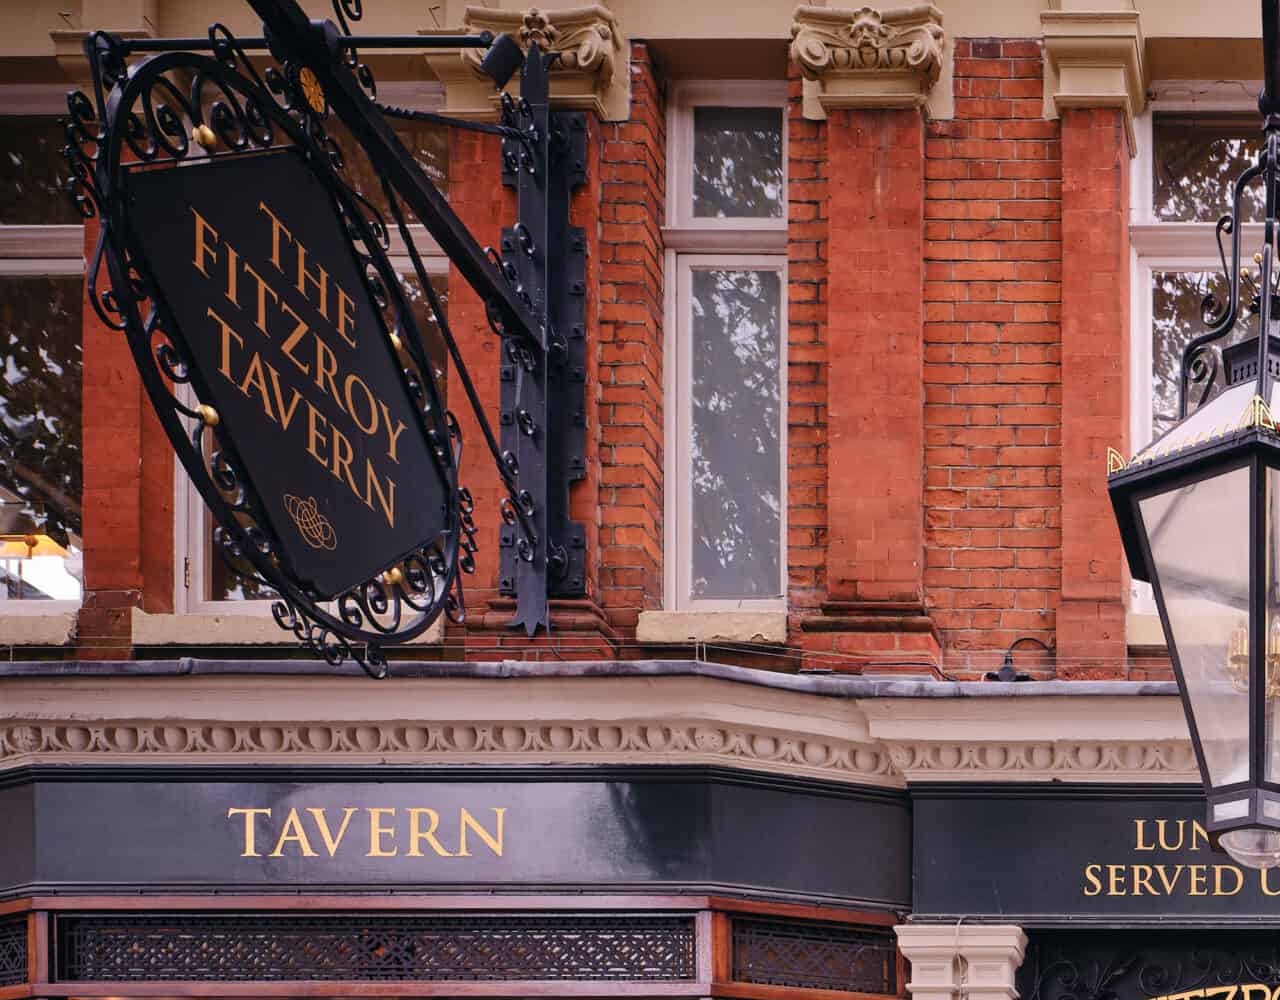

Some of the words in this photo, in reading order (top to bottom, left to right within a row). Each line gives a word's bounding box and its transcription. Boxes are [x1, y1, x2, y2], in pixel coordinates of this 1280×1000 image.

[190, 206, 408, 465] FITZROY
[256, 200, 357, 349] THE
[207, 306, 396, 529] TAVERN
[227, 807, 508, 857] TAVERN
[1083, 864, 1244, 896] SERVED
